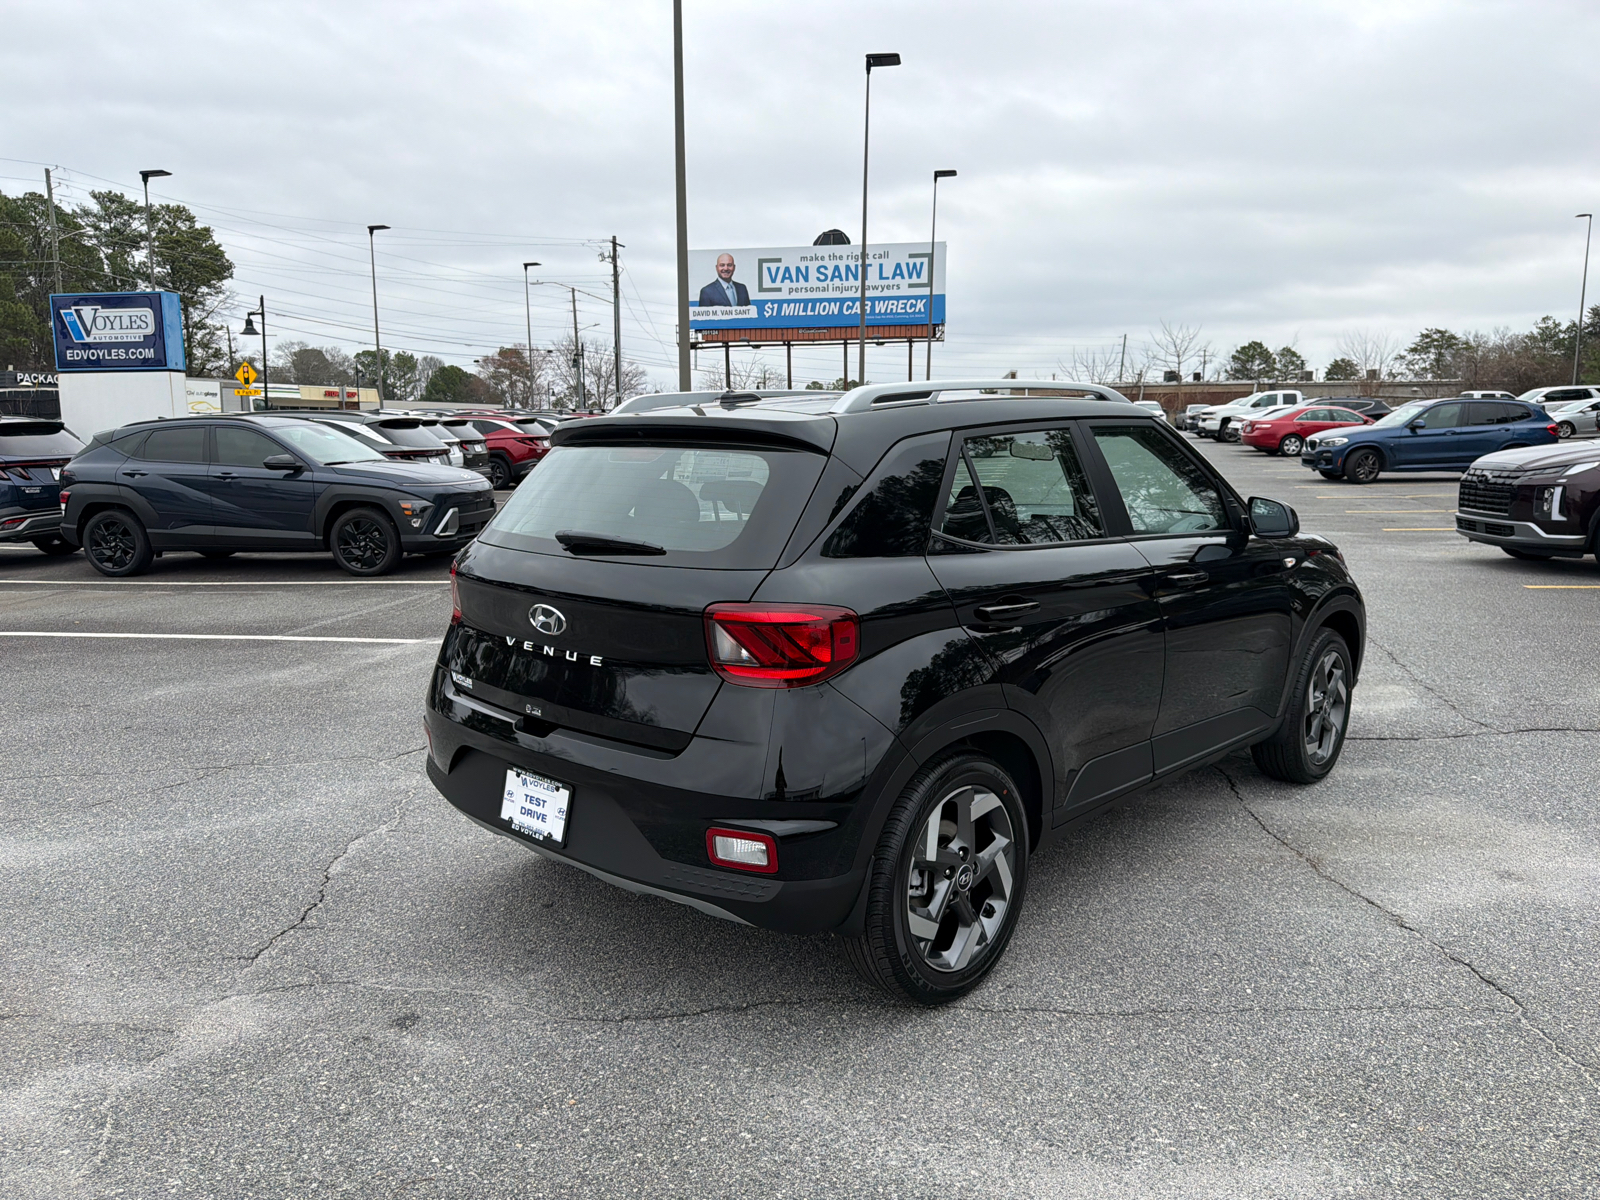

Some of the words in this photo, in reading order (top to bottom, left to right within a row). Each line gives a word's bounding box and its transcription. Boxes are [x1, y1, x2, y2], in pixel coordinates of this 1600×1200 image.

[800, 253, 825, 262] make
[828, 252, 843, 261] the
[847, 251, 869, 262] rigt
[872, 250, 889, 260] call
[766, 265, 809, 284] VAN
[816, 263, 872, 282] SANT
[878, 261, 924, 281] LAW
[788, 283, 829, 295] personal
[832, 282, 860, 294] injury
[864, 282, 901, 293] awyers
[692, 309, 711, 317] DAVID
[712, 309, 719, 317] M.
[734, 308, 750, 316] SANT
[763, 302, 778, 318] $1
[781, 301, 840, 316] MILLION
[842, 301, 871, 315] CAR
[875, 298, 927, 314] WRECK
[73, 307, 149, 338] VOYLES
[66, 348, 155, 360] EDVOYLES.COM
[505, 636, 603, 667] VENUE
[528, 778, 555, 793] VOYLES
[523, 793, 548, 809] TEST
[519, 805, 548, 823] DRIVE
[511, 823, 520, 831] ED
[520, 827, 544, 841] VOYLES
